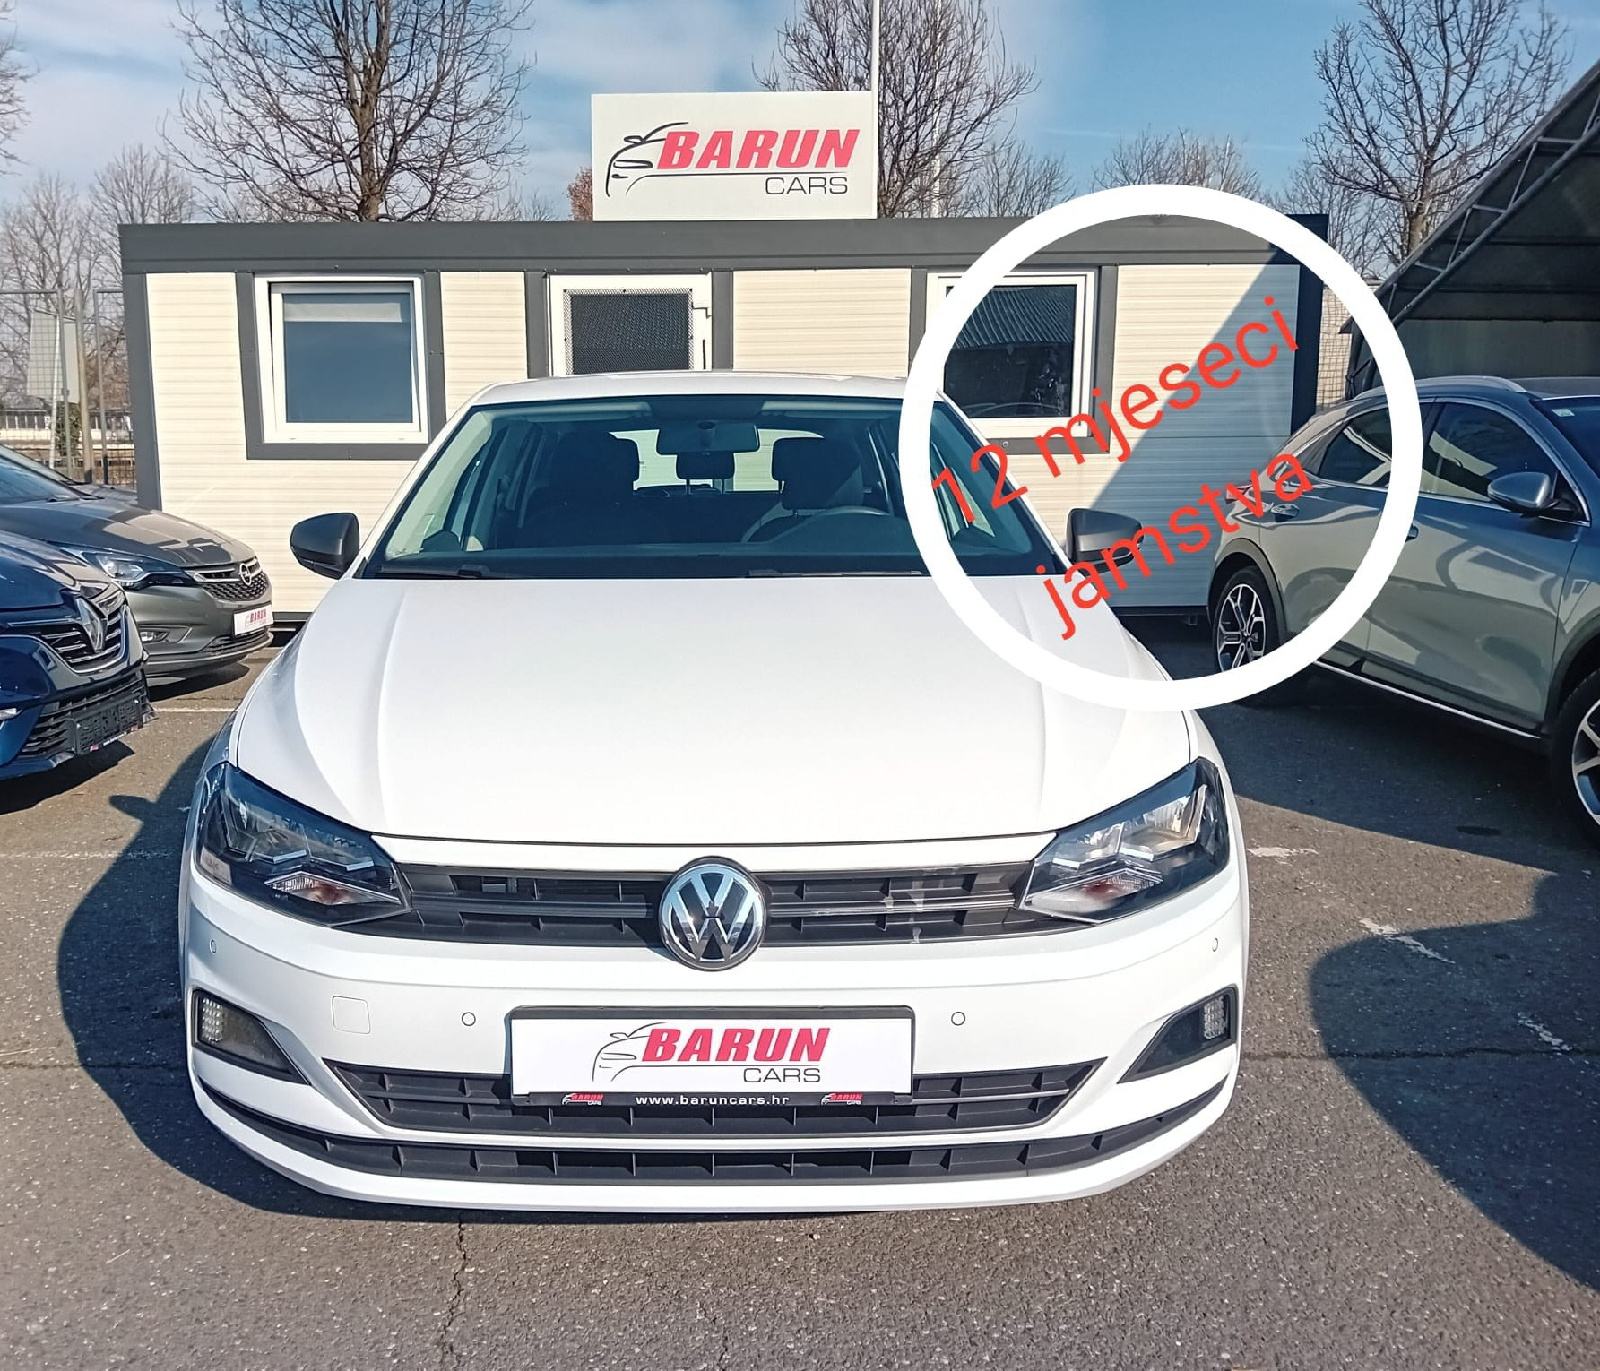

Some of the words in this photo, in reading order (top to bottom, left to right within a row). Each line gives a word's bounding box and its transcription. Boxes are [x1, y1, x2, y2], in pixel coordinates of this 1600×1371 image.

[657, 129, 860, 169] BARUN
[765, 176, 848, 195] CARS
[642, 1027, 830, 1062] BARUN
[743, 1067, 821, 1083] CARS
[635, 1094, 790, 1105] www.baruncars.hr
